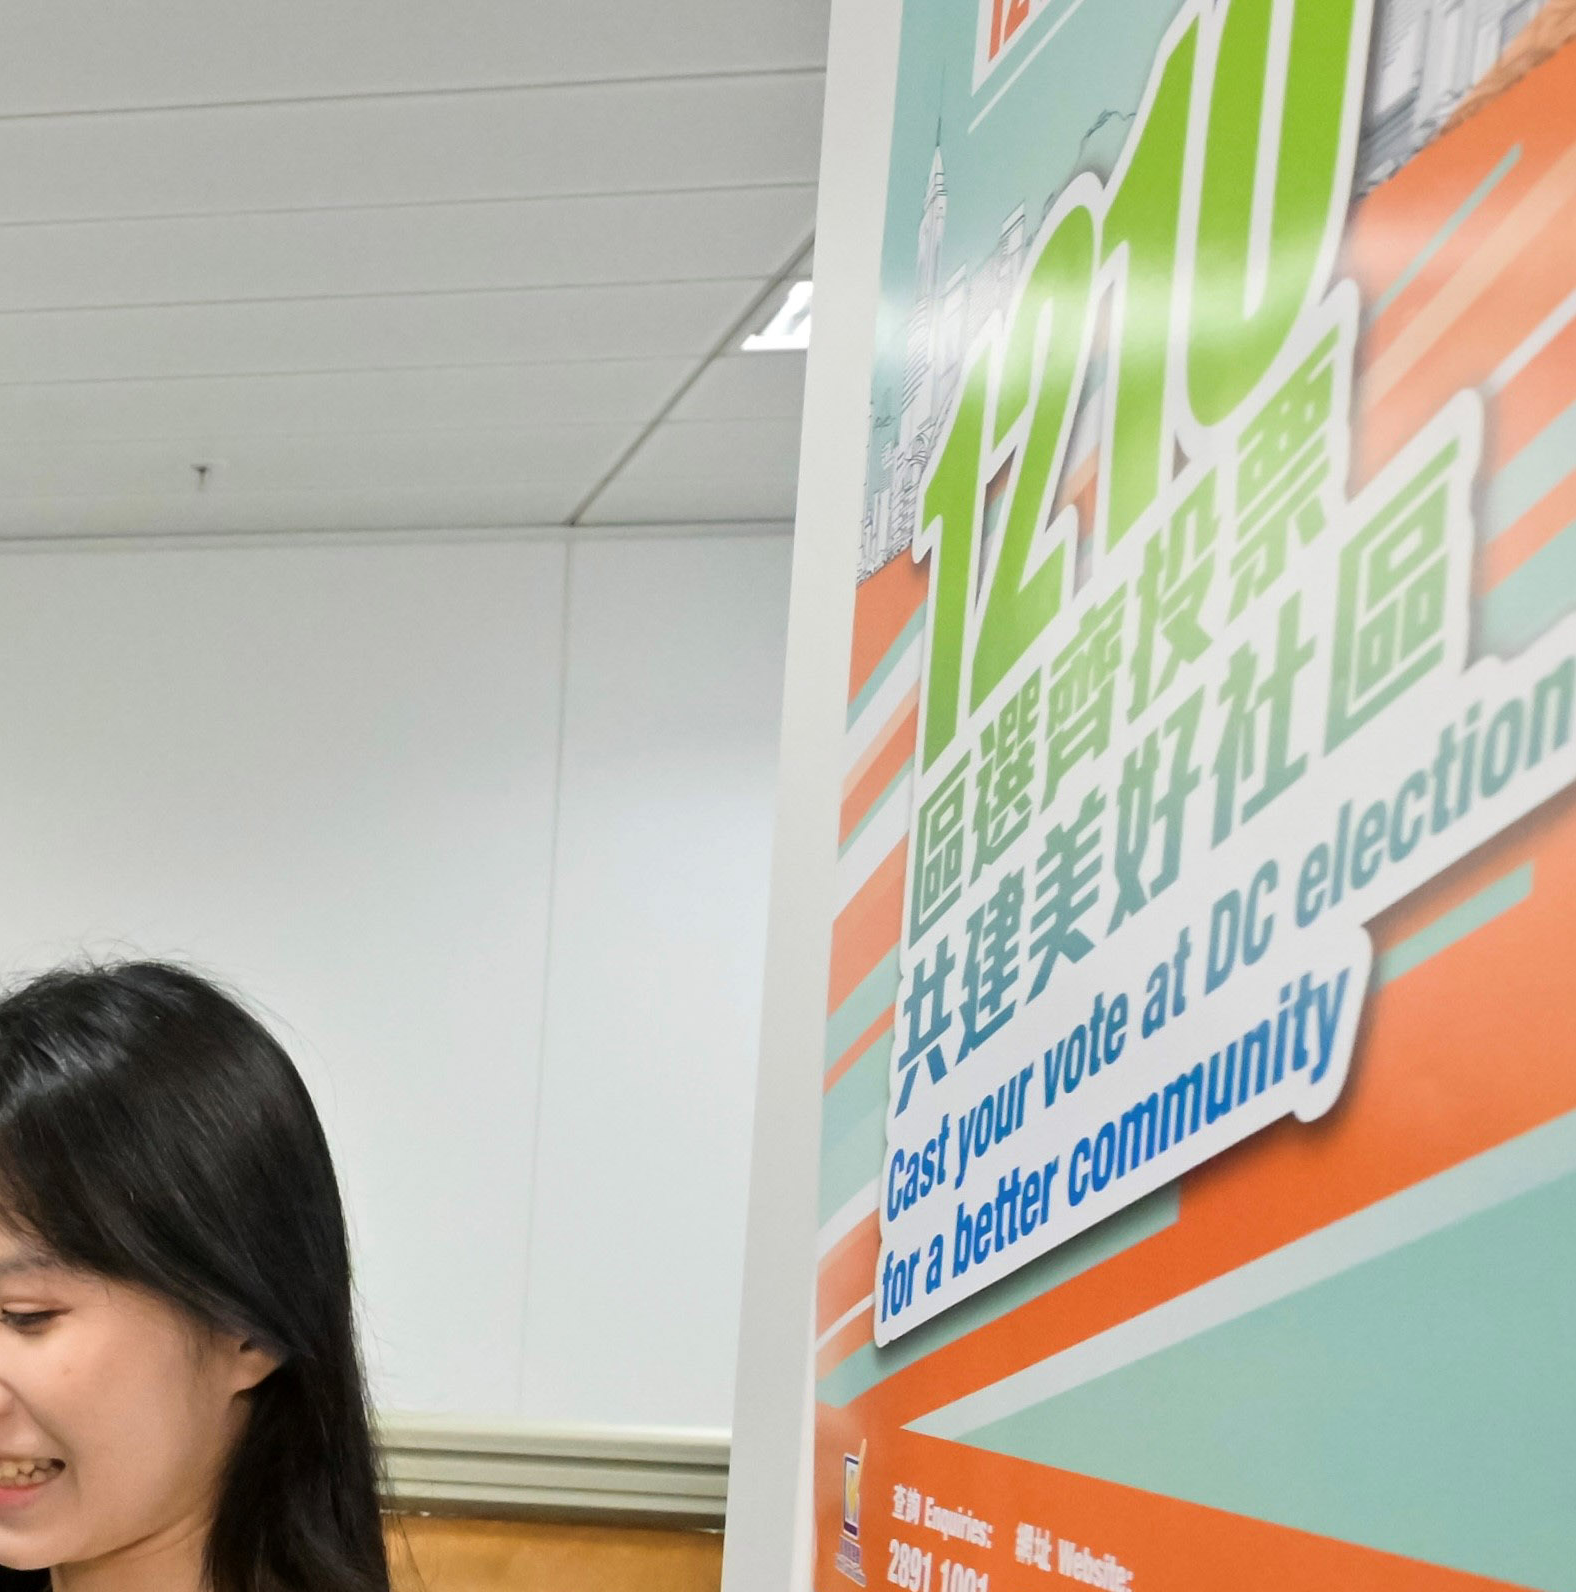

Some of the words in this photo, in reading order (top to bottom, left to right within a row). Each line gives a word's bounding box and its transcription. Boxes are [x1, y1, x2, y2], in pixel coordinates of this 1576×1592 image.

[908, 312, 1343, 949] 區選齊投票
[922, 0, 1351, 778] 1210
[886, 1116, 949, 1223] Cast
[955, 1060, 1034, 1190] your
[1042, 990, 1128, 1108] vote
[1141, 923, 1192, 1040] at
[1204, 857, 1280, 997] DC
[1295, 654, 1576, 929] election
[894, 433, 1459, 1119] 共建美好社區
[880, 1247, 922, 1324] for
[925, 1237, 945, 1295] a
[952, 1155, 1061, 1280] better
[1067, 966, 1352, 1209] community
[924, 1496, 994, 1549] Enquiries:
